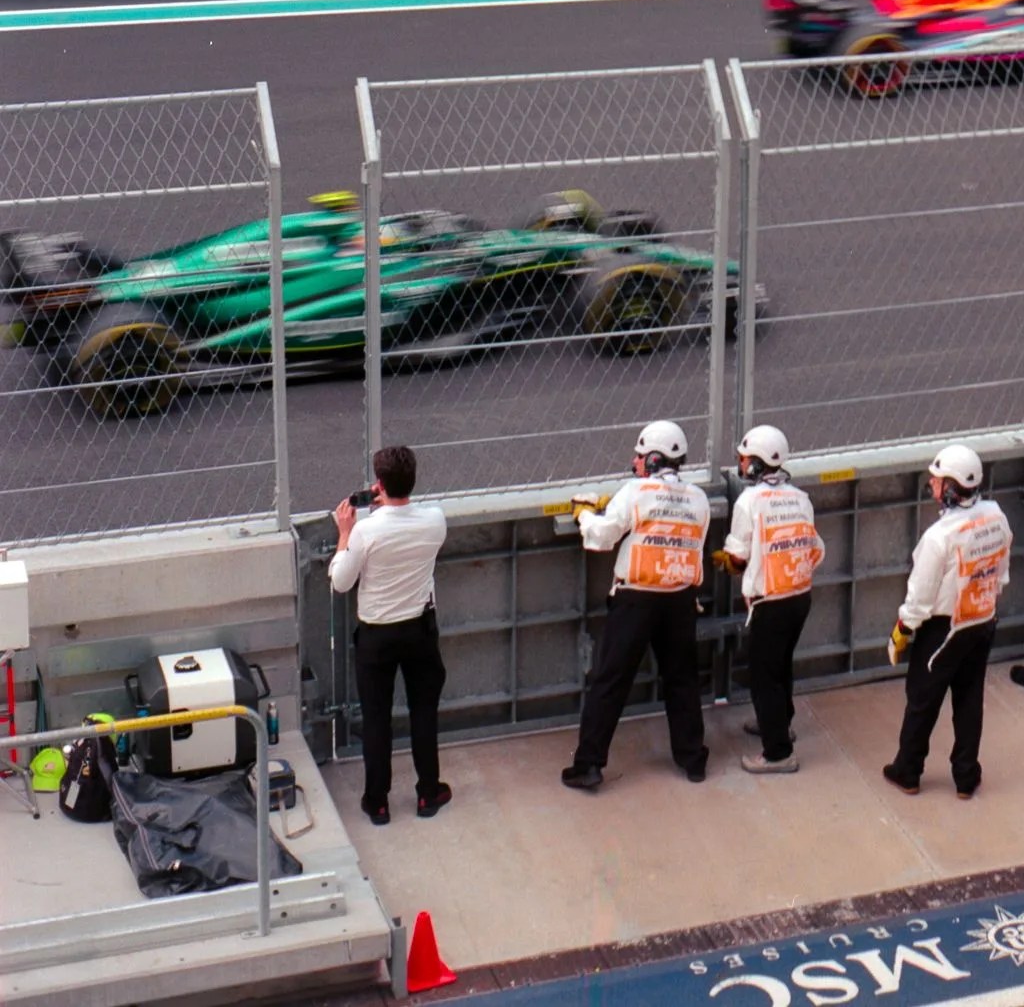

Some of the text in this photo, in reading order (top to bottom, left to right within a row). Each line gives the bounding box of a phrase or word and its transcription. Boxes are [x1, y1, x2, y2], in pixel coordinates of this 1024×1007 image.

[643, 534, 682, 547] MIAMI
[689, 918, 930, 975] CRUISES
[708, 936, 972, 1007] MSC
